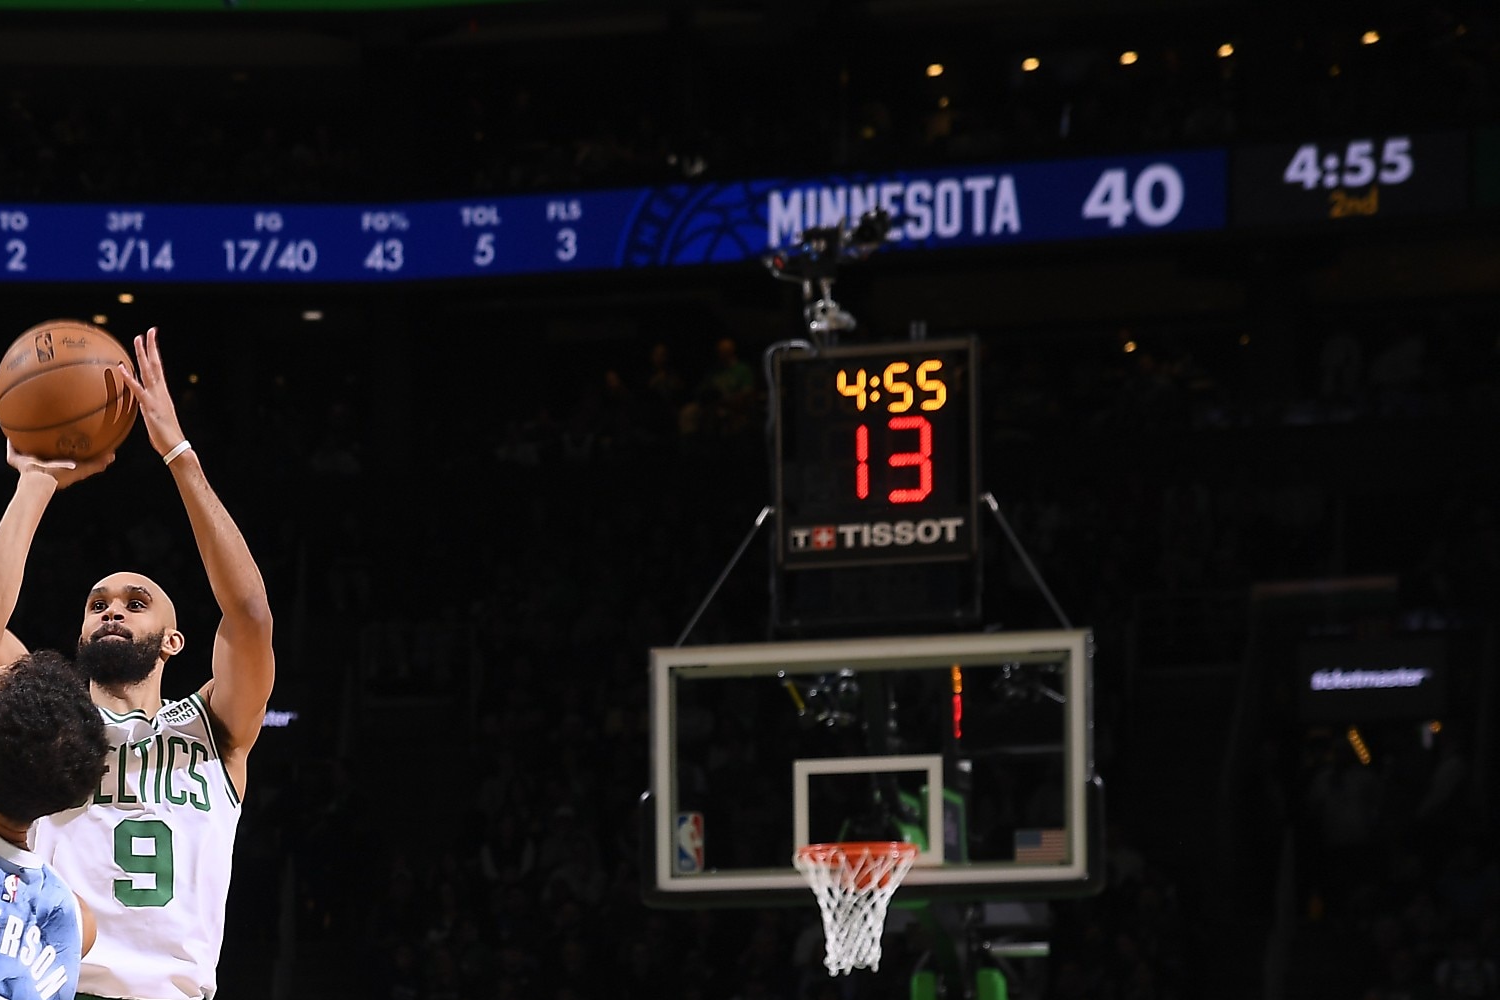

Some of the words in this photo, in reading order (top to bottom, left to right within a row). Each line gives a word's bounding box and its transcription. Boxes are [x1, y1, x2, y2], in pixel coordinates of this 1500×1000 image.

[1283, 137, 1413, 190] 4:55
[0, 210, 28, 231] TO
[107, 212, 144, 231] 3PT
[255, 213, 282, 231] FG
[362, 213, 409, 231] FG%
[461, 207, 500, 227] TOL
[547, 201, 581, 221] FLS
[1082, 163, 1184, 228] 40
[1329, 187, 1378, 218] 2nd
[6, 239, 27, 271] 2
[98, 240, 174, 272] 3/14
[223, 240, 318, 272] 17/40
[364, 240, 404, 272] 43
[474, 233, 495, 266] 5
[556, 229, 578, 262] 3
[836, 359, 947, 413] 4:55
[855, 415, 933, 504] 13
[838, 517, 964, 548] TISSOT
[93, 734, 212, 812] ELTICS
[114, 819, 174, 907] 9
